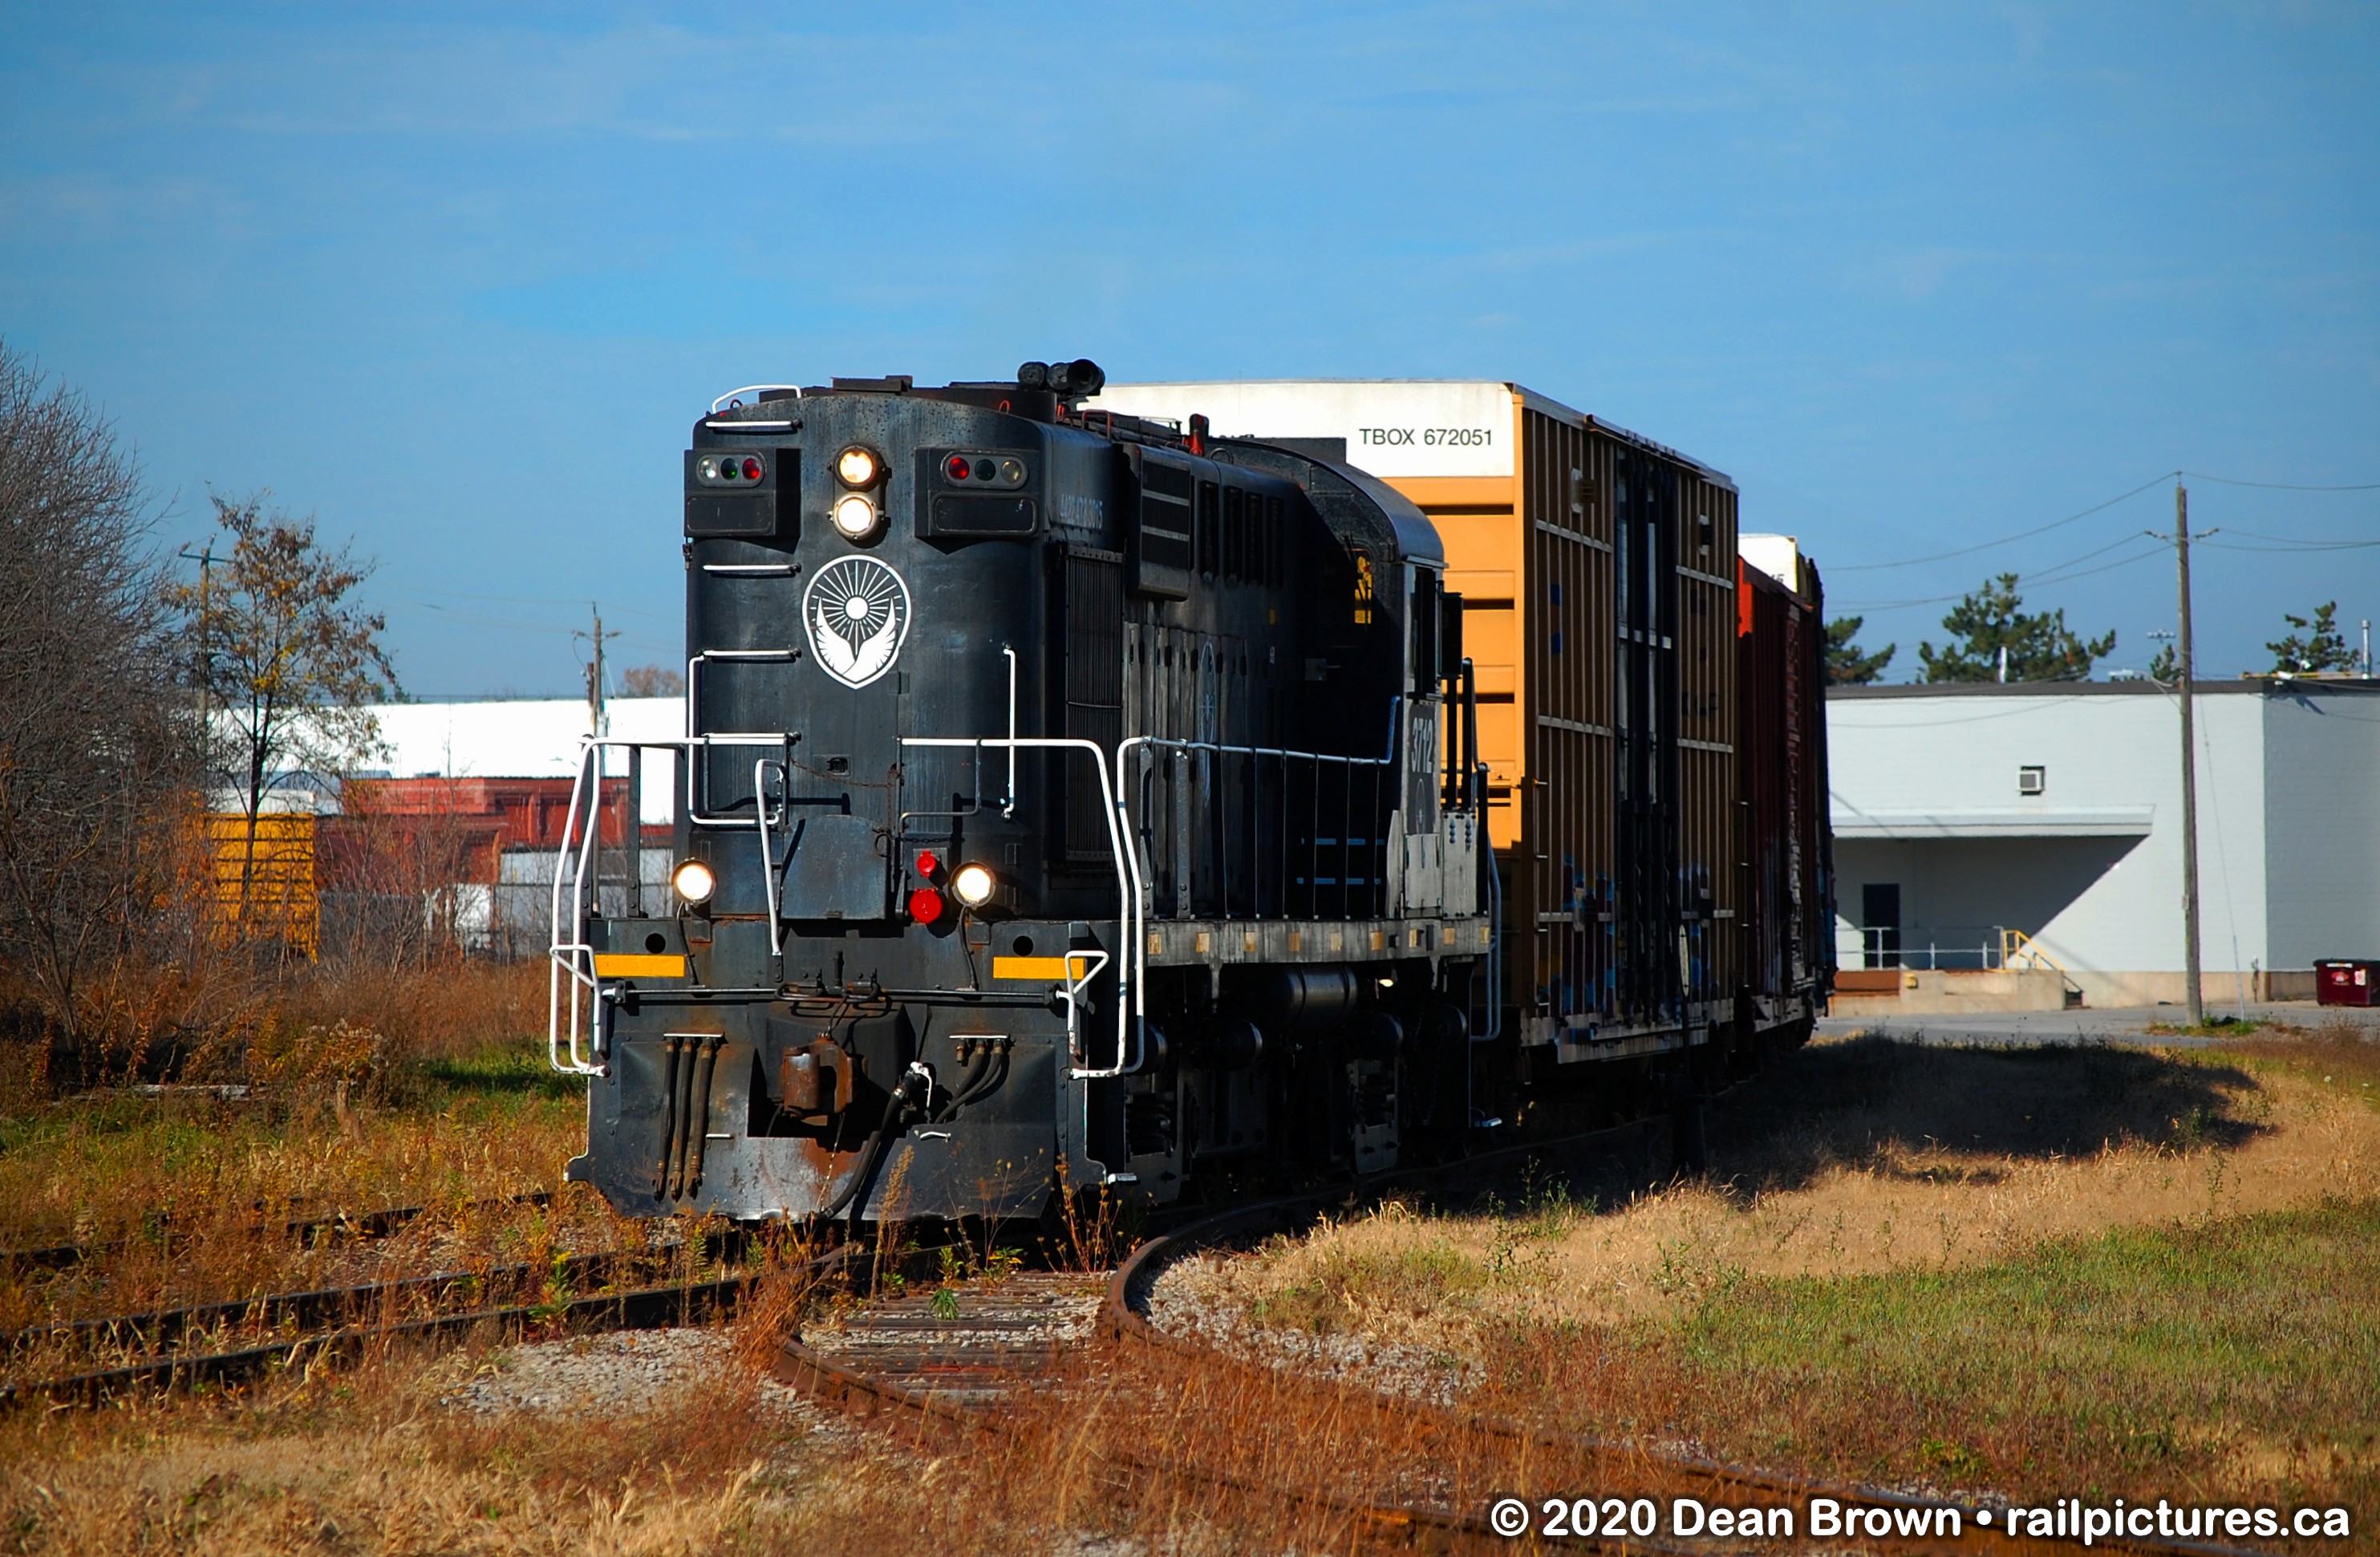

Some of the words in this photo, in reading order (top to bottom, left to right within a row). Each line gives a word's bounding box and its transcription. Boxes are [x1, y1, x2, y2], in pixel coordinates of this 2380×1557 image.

[1358, 428, 1415, 445] TBOX
[1424, 428, 1491, 446] 672051
[1412, 716, 1433, 774] 3712
